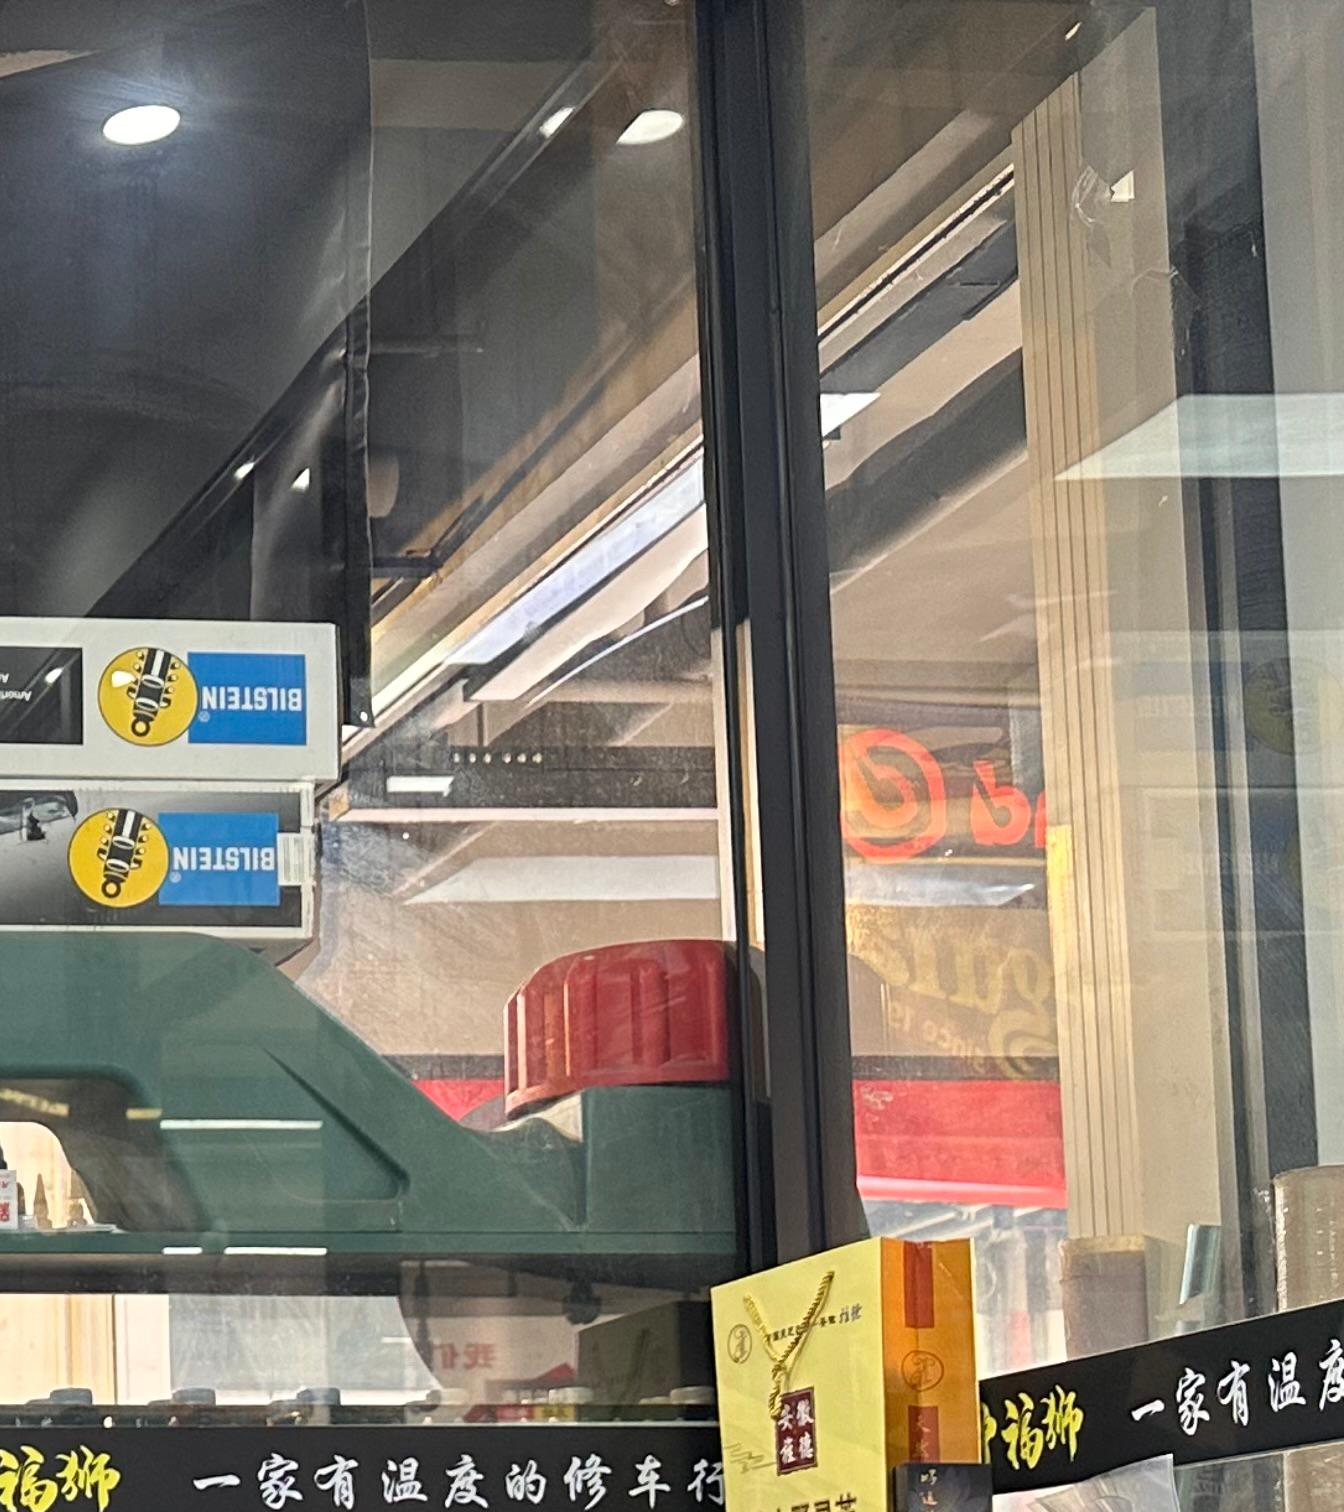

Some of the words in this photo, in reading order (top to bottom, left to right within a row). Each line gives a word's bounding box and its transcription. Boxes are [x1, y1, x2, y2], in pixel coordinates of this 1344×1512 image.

[201, 686, 303, 712] BILSTEIN
[172, 847, 276, 872] BILSTEIN
[192, 1451, 726, 1512] 一家有温度的修车行
